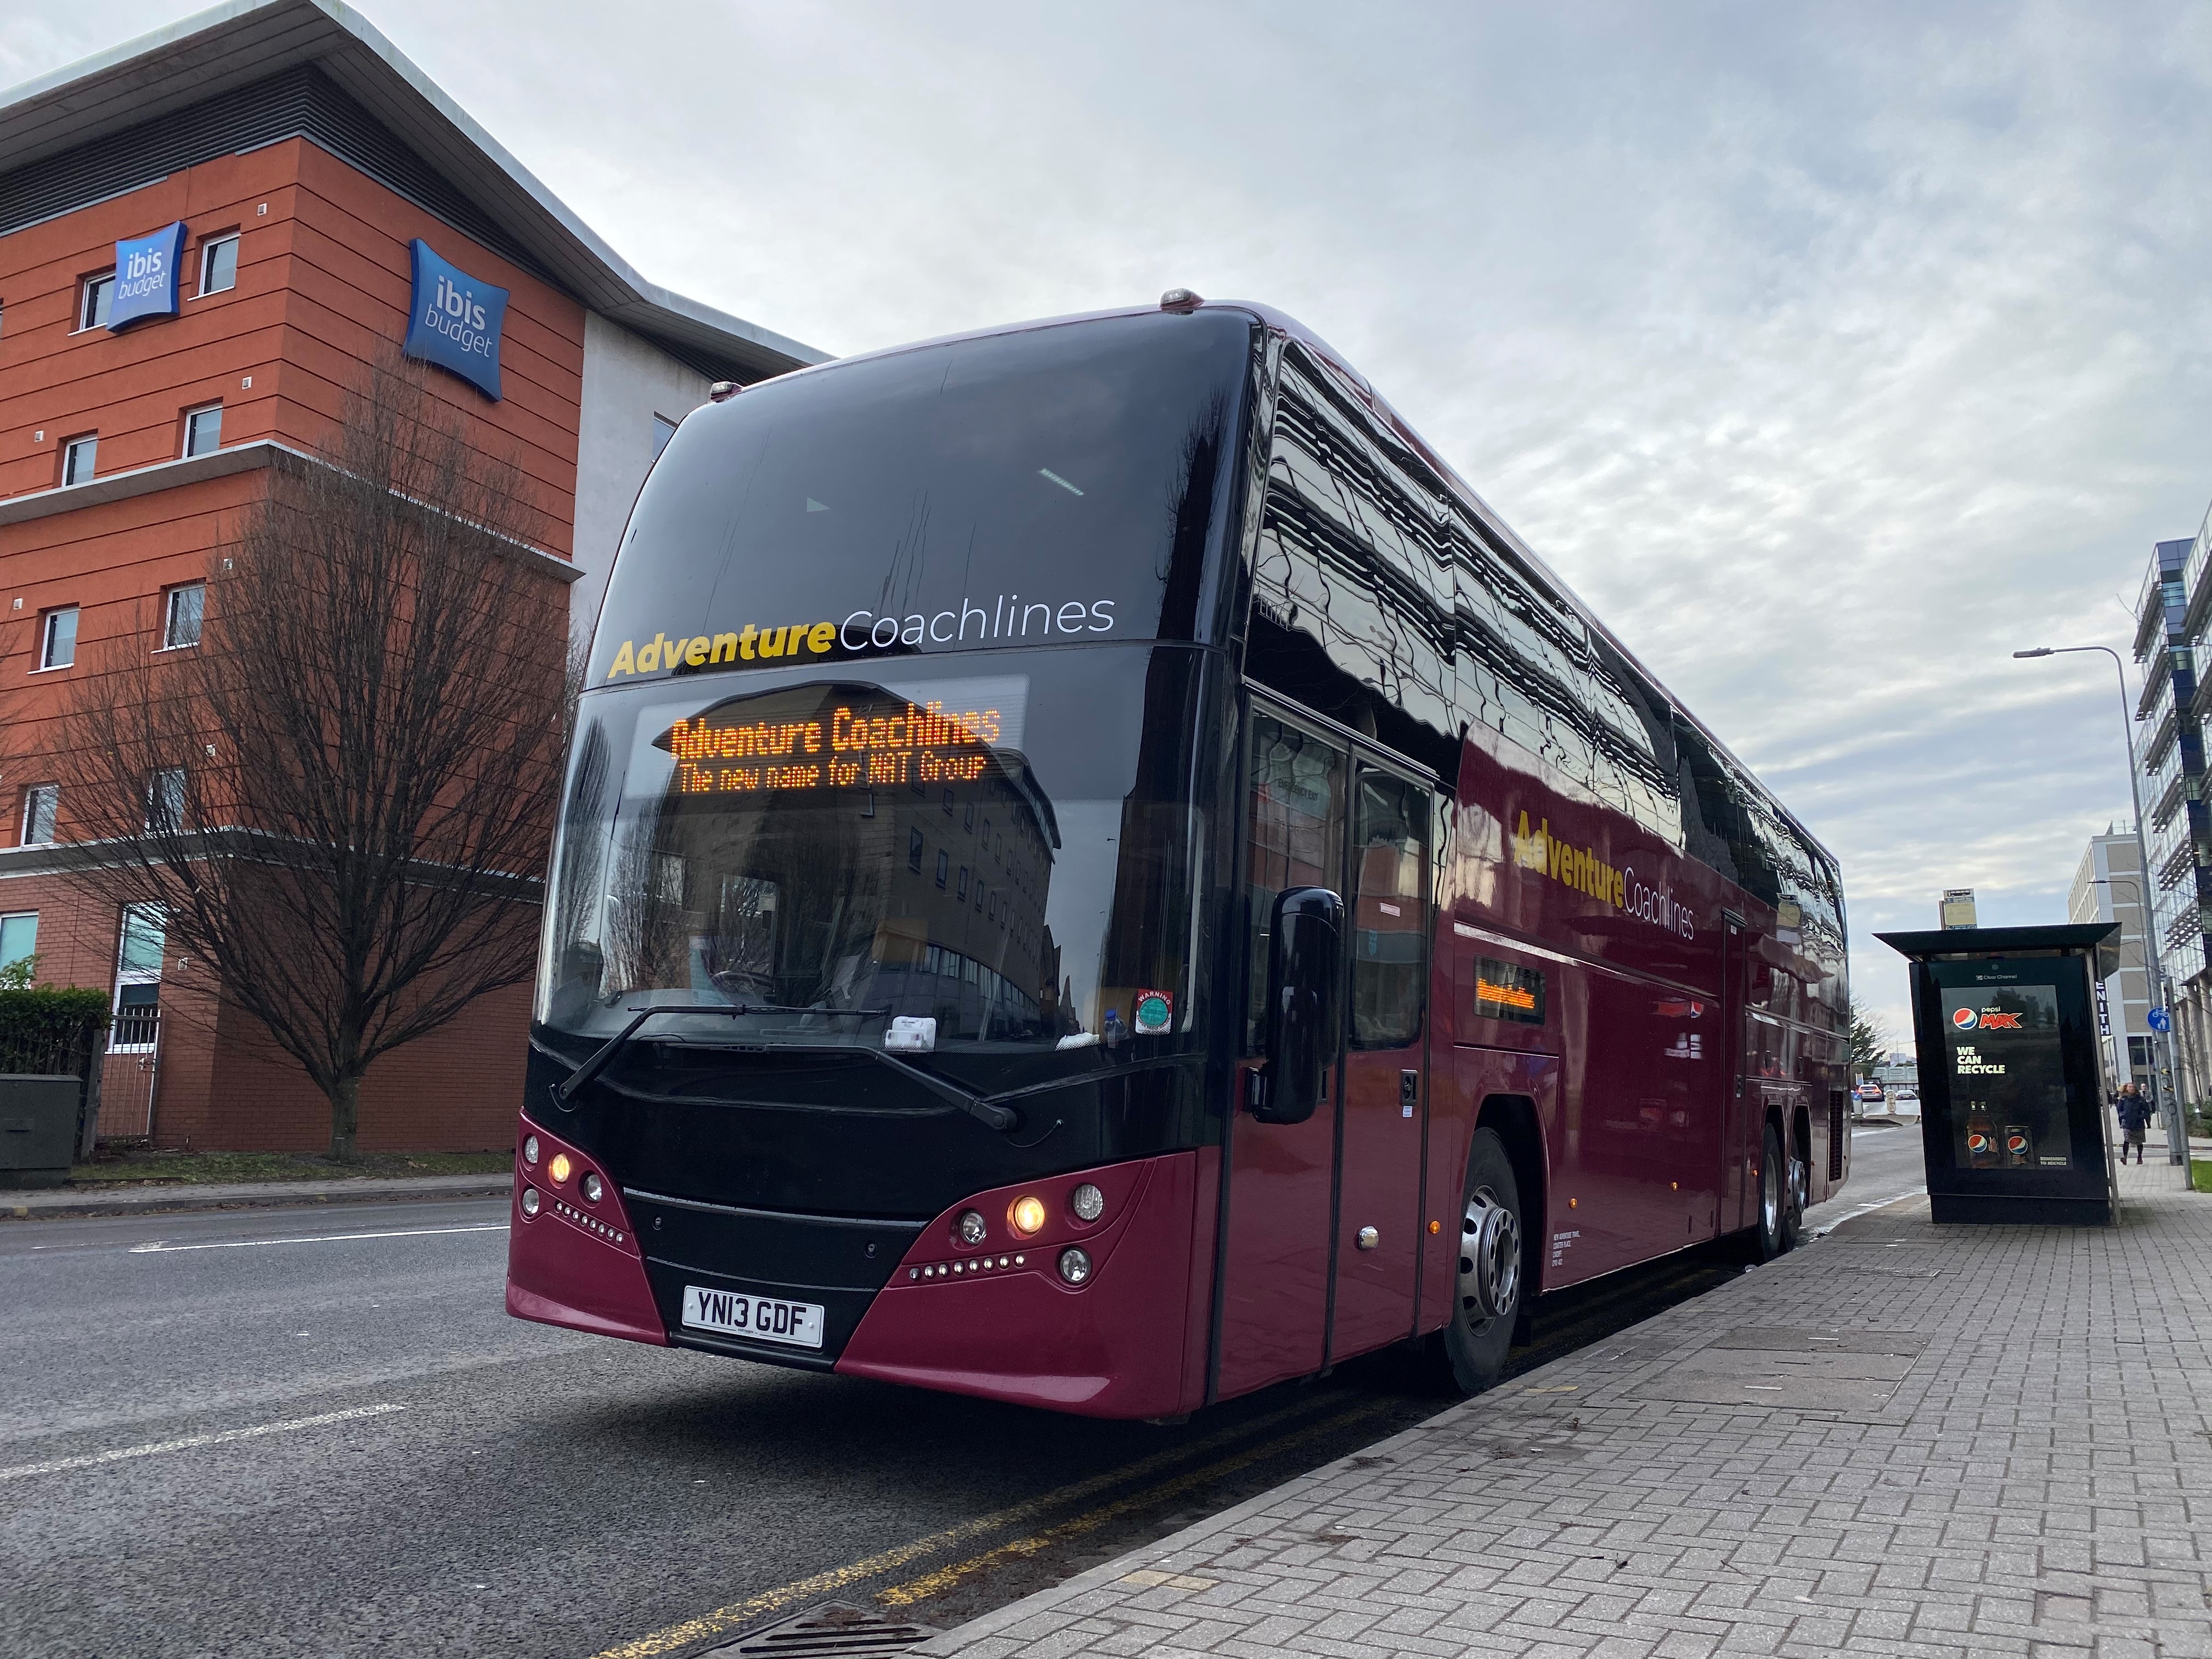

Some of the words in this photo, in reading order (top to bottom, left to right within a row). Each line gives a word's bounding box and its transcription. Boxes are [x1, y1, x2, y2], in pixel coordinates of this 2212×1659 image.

[127, 247, 162, 279] ibis
[119, 270, 166, 299] budget
[437, 275, 486, 330] ibis
[425, 303, 492, 357] budget
[607, 622, 836, 679] Adventure
[840, 594, 1115, 650] Coachlines
[671, 717, 821, 759] Adventure
[832, 701, 1000, 751] Coachlines
[680, 763, 713, 792] The
[720, 769, 759, 790] new
[766, 765, 820, 788] name
[828, 755, 861, 785] for
[920, 750, 986, 781] Group
[1514, 810, 1624, 908] Adventure
[1624, 867, 1694, 940] Coachlines
[1138, 991, 1171, 1005] WARNING
[1978, 1013, 2023, 1030] MAX
[1956, 1046, 1975, 1055] WE
[1957, 1056, 1982, 1064] CAN
[1957, 1065, 2005, 1074] RECYCLE
[698, 1291, 749, 1328] YN13
[756, 1301, 806, 1335] GDF
